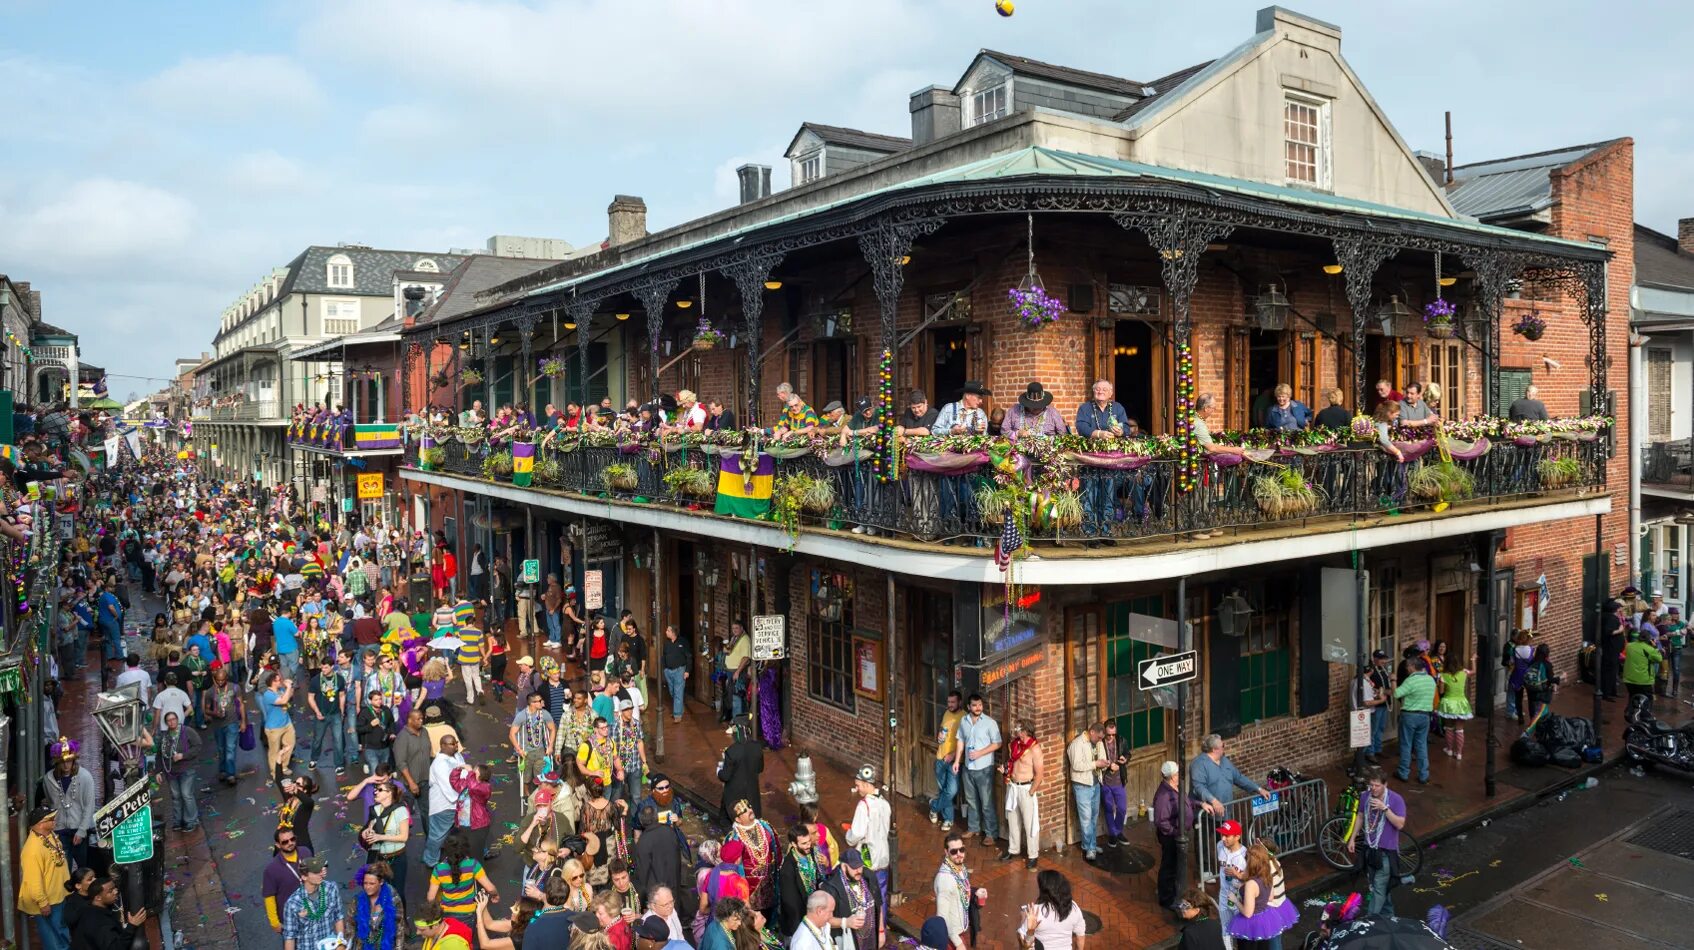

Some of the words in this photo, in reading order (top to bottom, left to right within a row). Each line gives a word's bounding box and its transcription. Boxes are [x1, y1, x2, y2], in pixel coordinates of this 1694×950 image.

[982, 657, 1020, 684] BALCONY
[1157, 664, 1174, 677] ONE
[1176, 660, 1191, 672] WAY
[99, 816, 118, 836] St.
